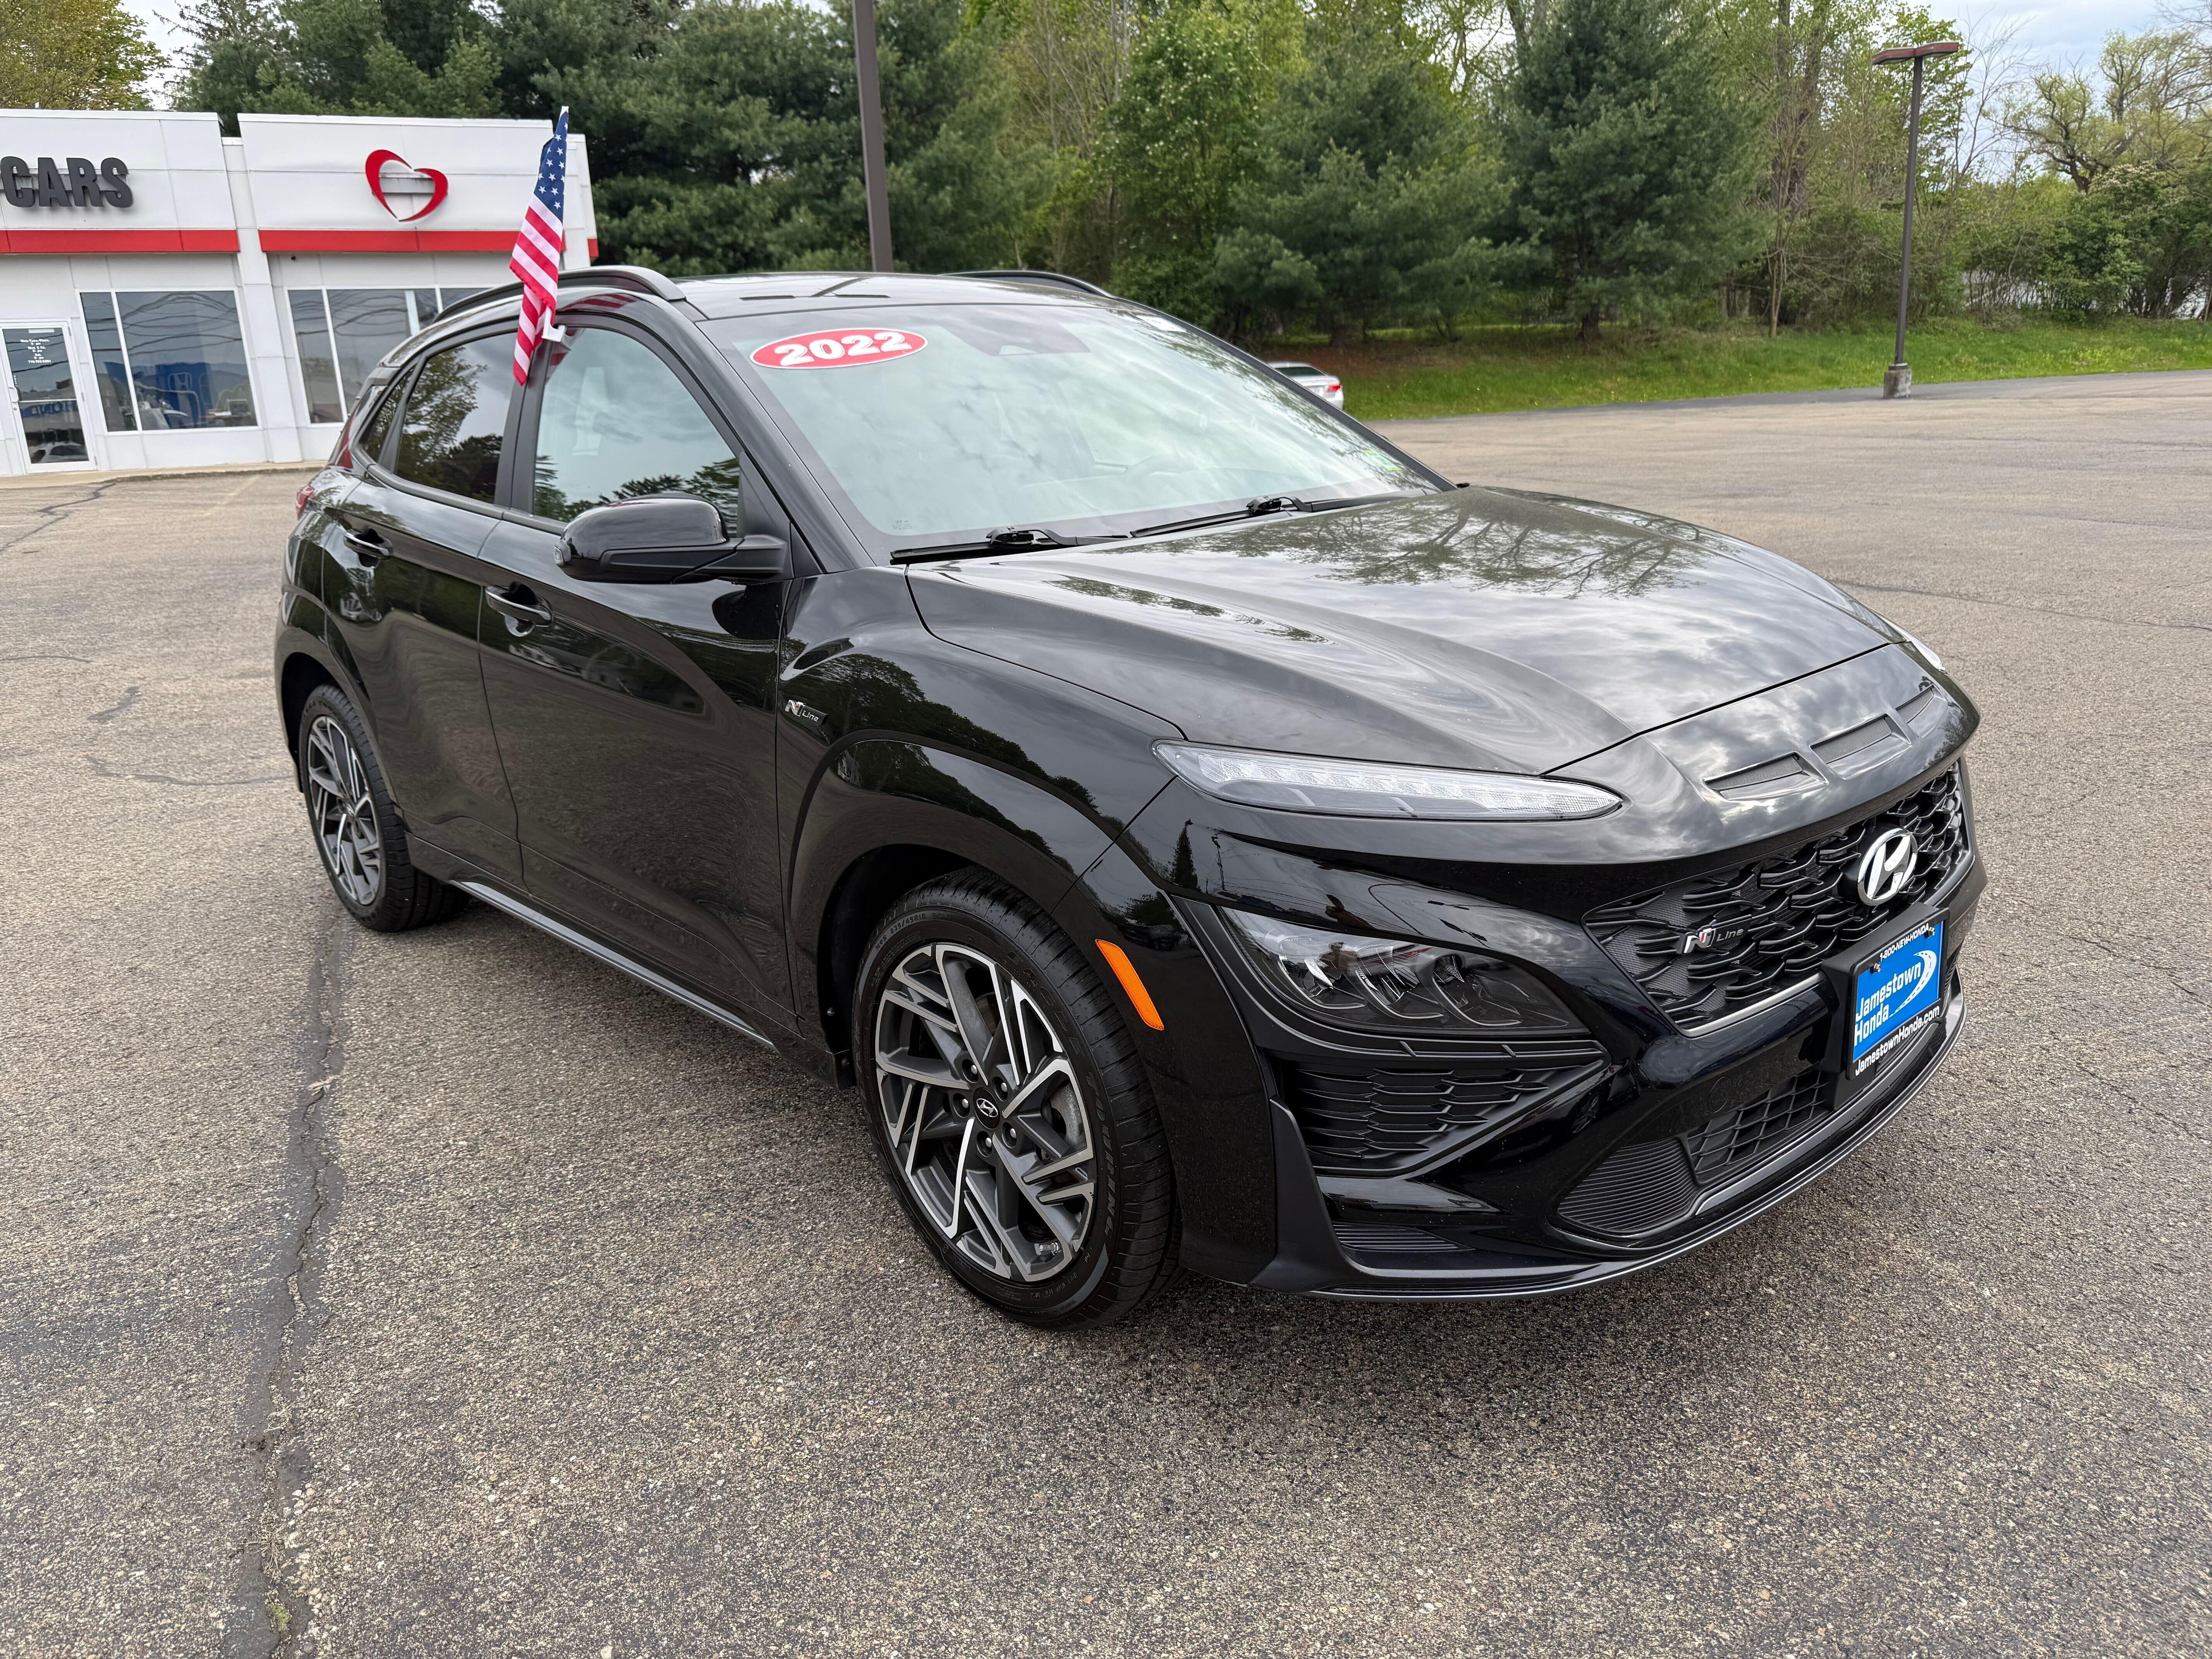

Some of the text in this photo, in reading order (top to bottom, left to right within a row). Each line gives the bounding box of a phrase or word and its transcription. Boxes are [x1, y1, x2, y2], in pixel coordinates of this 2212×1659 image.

[0, 156, 133, 208] CARS
[775, 332, 912, 366] 2022
[785, 699, 819, 722] N Line
[890, 913, 927, 934] 235/45R18
[1684, 928, 1743, 953] N Line
[1880, 923, 1929, 961] 1-800-NEW-HONDA
[1855, 962, 1921, 1022] Jamestown
[1854, 1003, 1889, 1047] Honda
[1855, 1006, 1940, 1076] JamestownHonda.com
[1007, 951, 1085, 1056] EAGLE
[1085, 1072, 1116, 1238] TOURING
